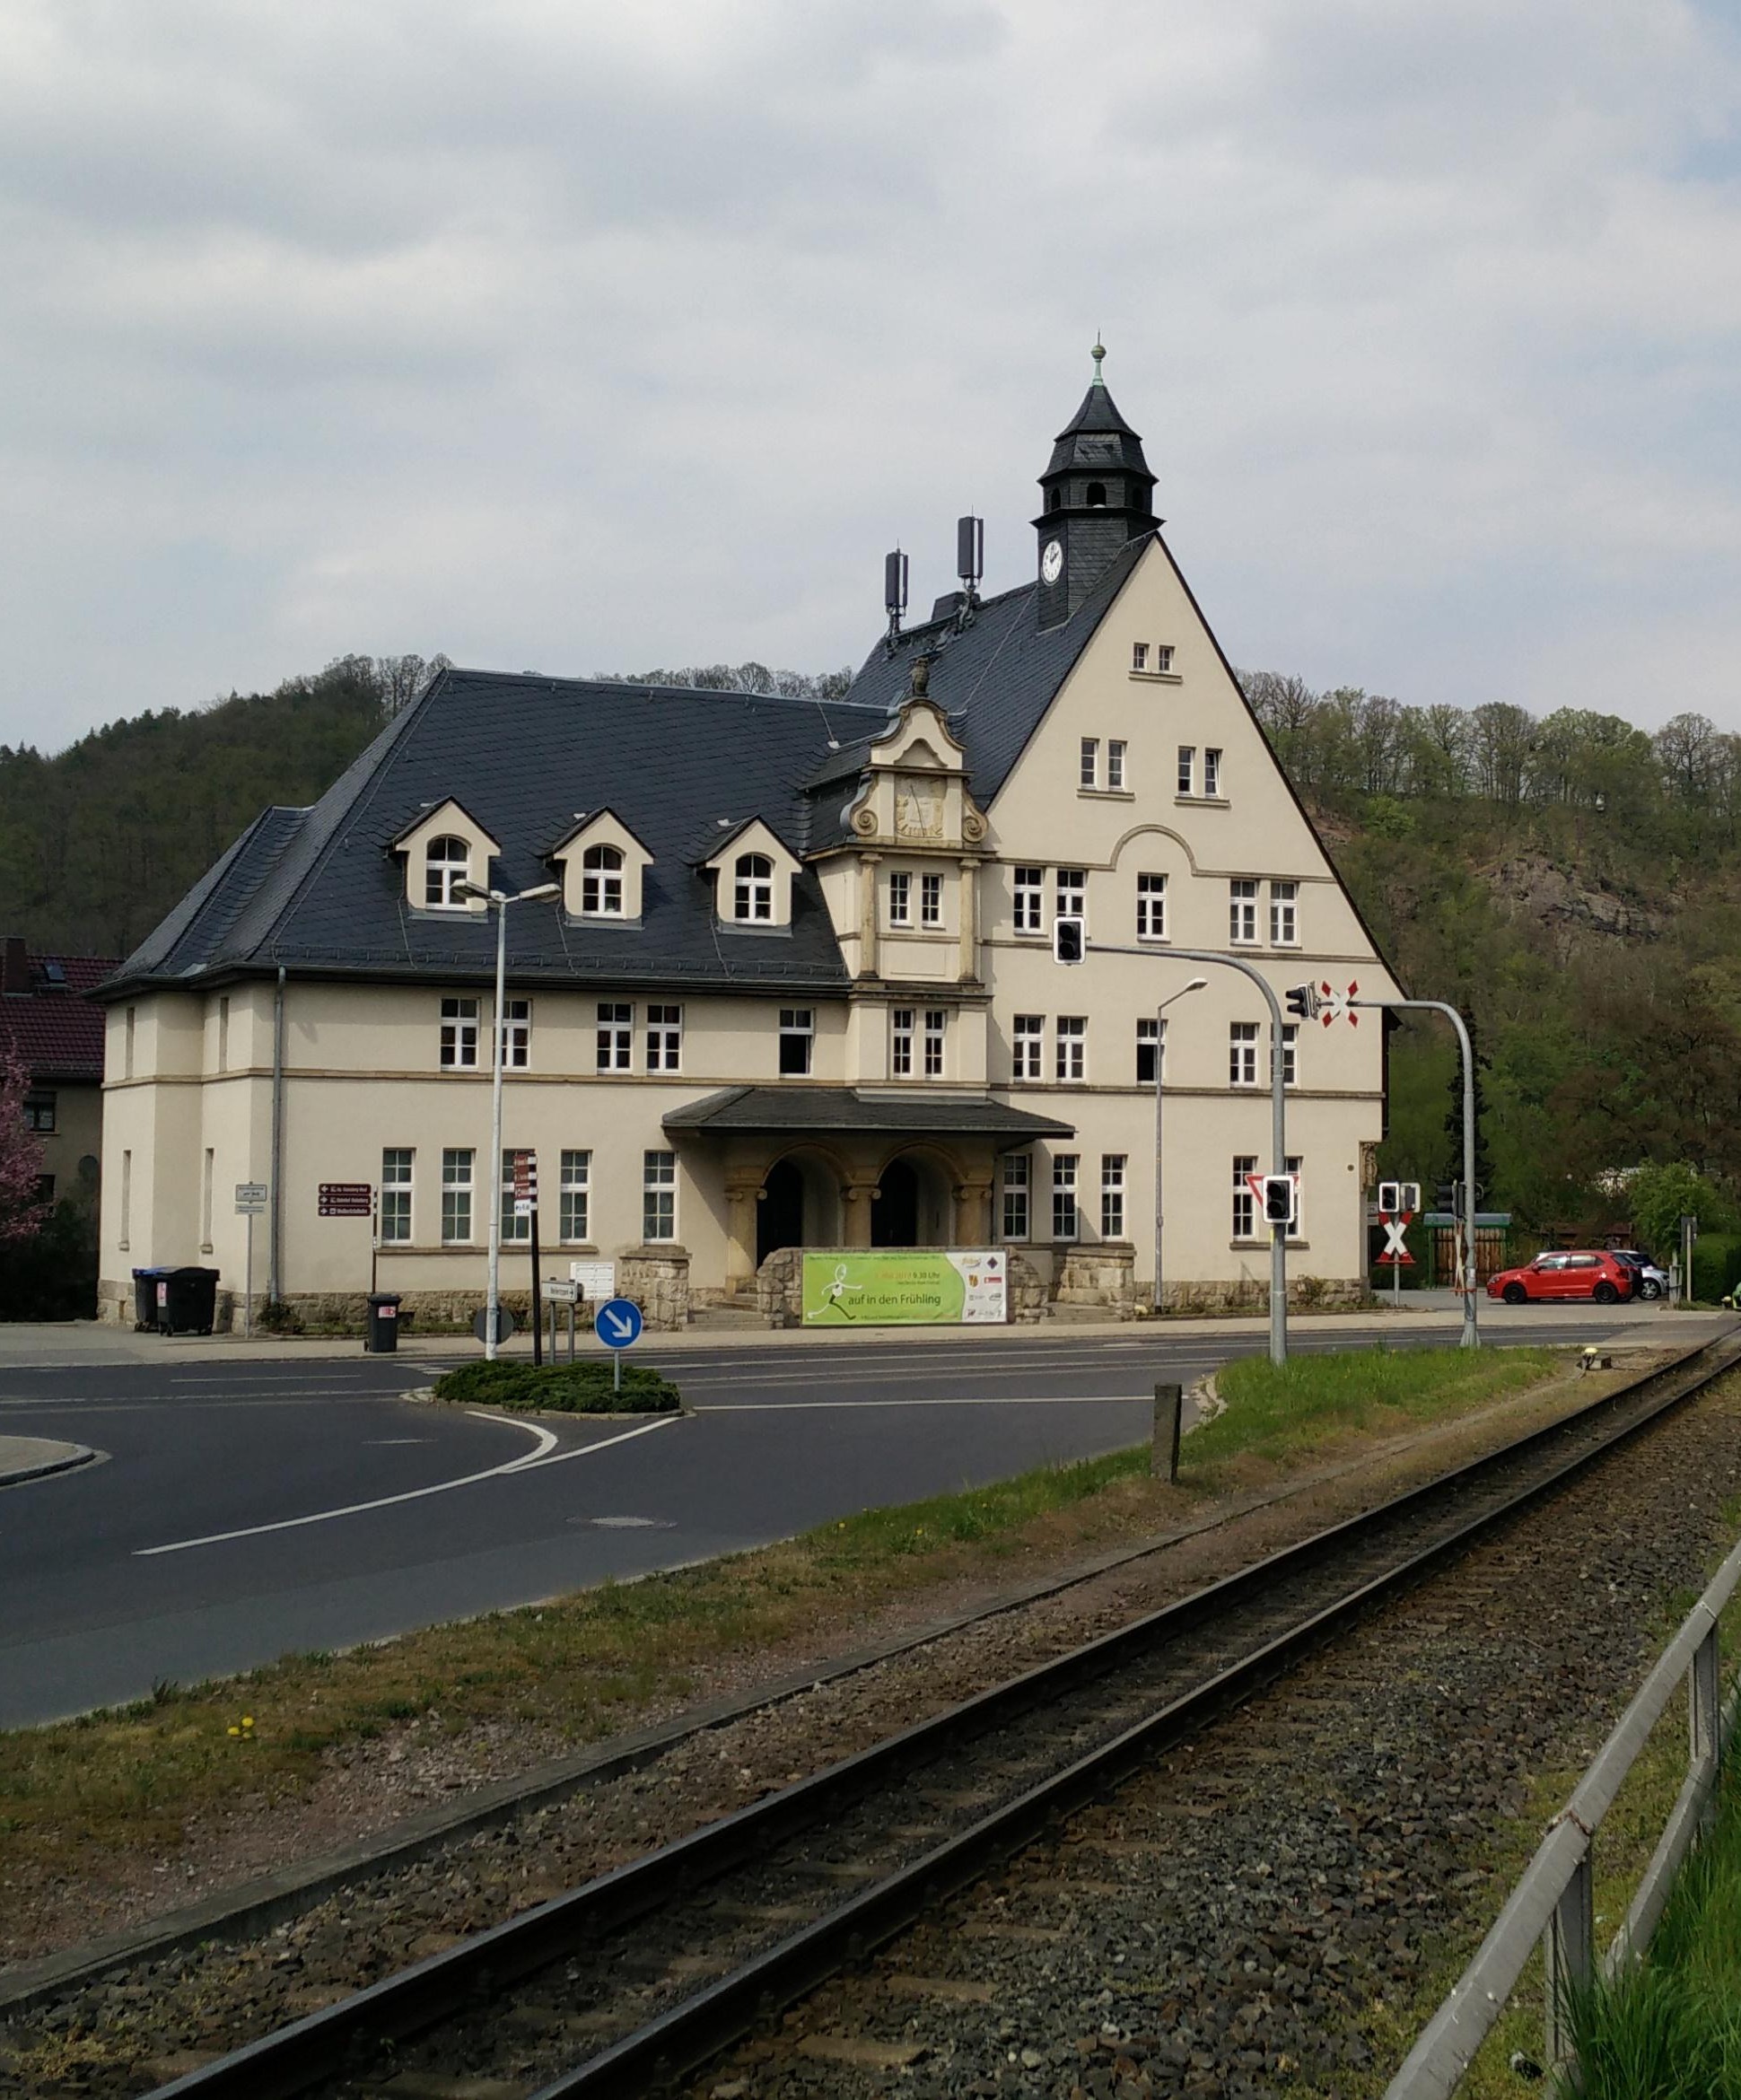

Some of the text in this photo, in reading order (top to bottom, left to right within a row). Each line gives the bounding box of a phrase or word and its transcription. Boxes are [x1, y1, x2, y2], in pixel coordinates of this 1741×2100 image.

[848, 1293, 941, 1307] auf in den Frühling
